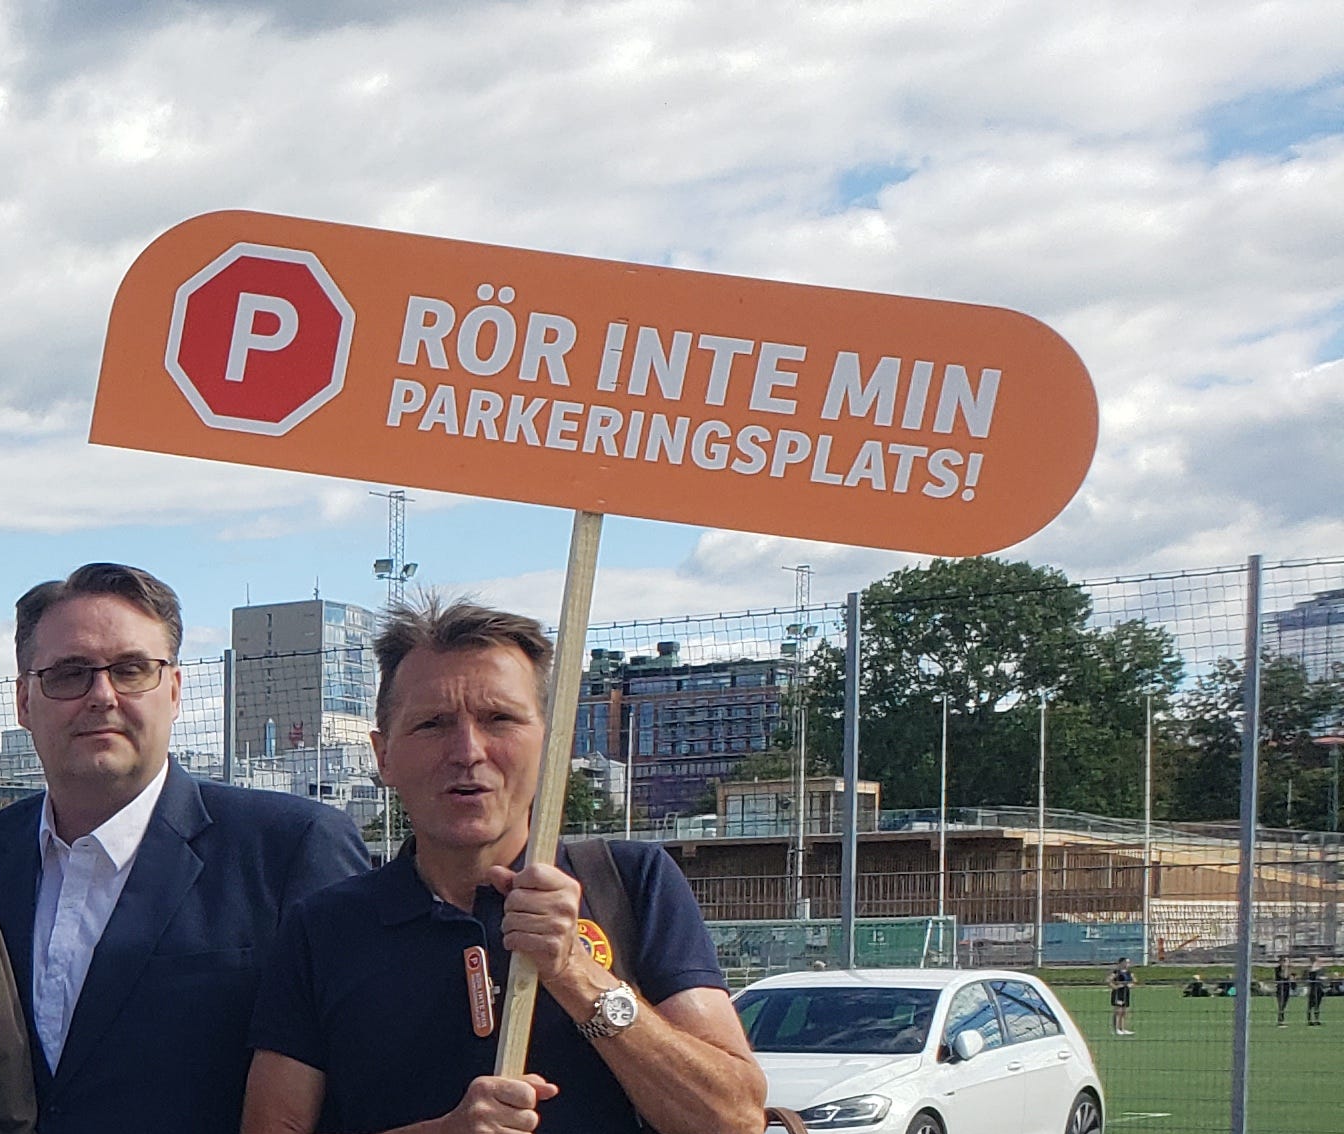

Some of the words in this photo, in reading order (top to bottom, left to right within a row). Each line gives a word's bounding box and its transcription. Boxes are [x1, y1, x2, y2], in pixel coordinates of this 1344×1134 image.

[225, 292, 298, 382] P
[397, 284, 576, 387] RÖR
[597, 322, 806, 414] INTE
[821, 351, 1002, 438] MIN
[387, 379, 985, 502] PARKERINGSPLATS!
